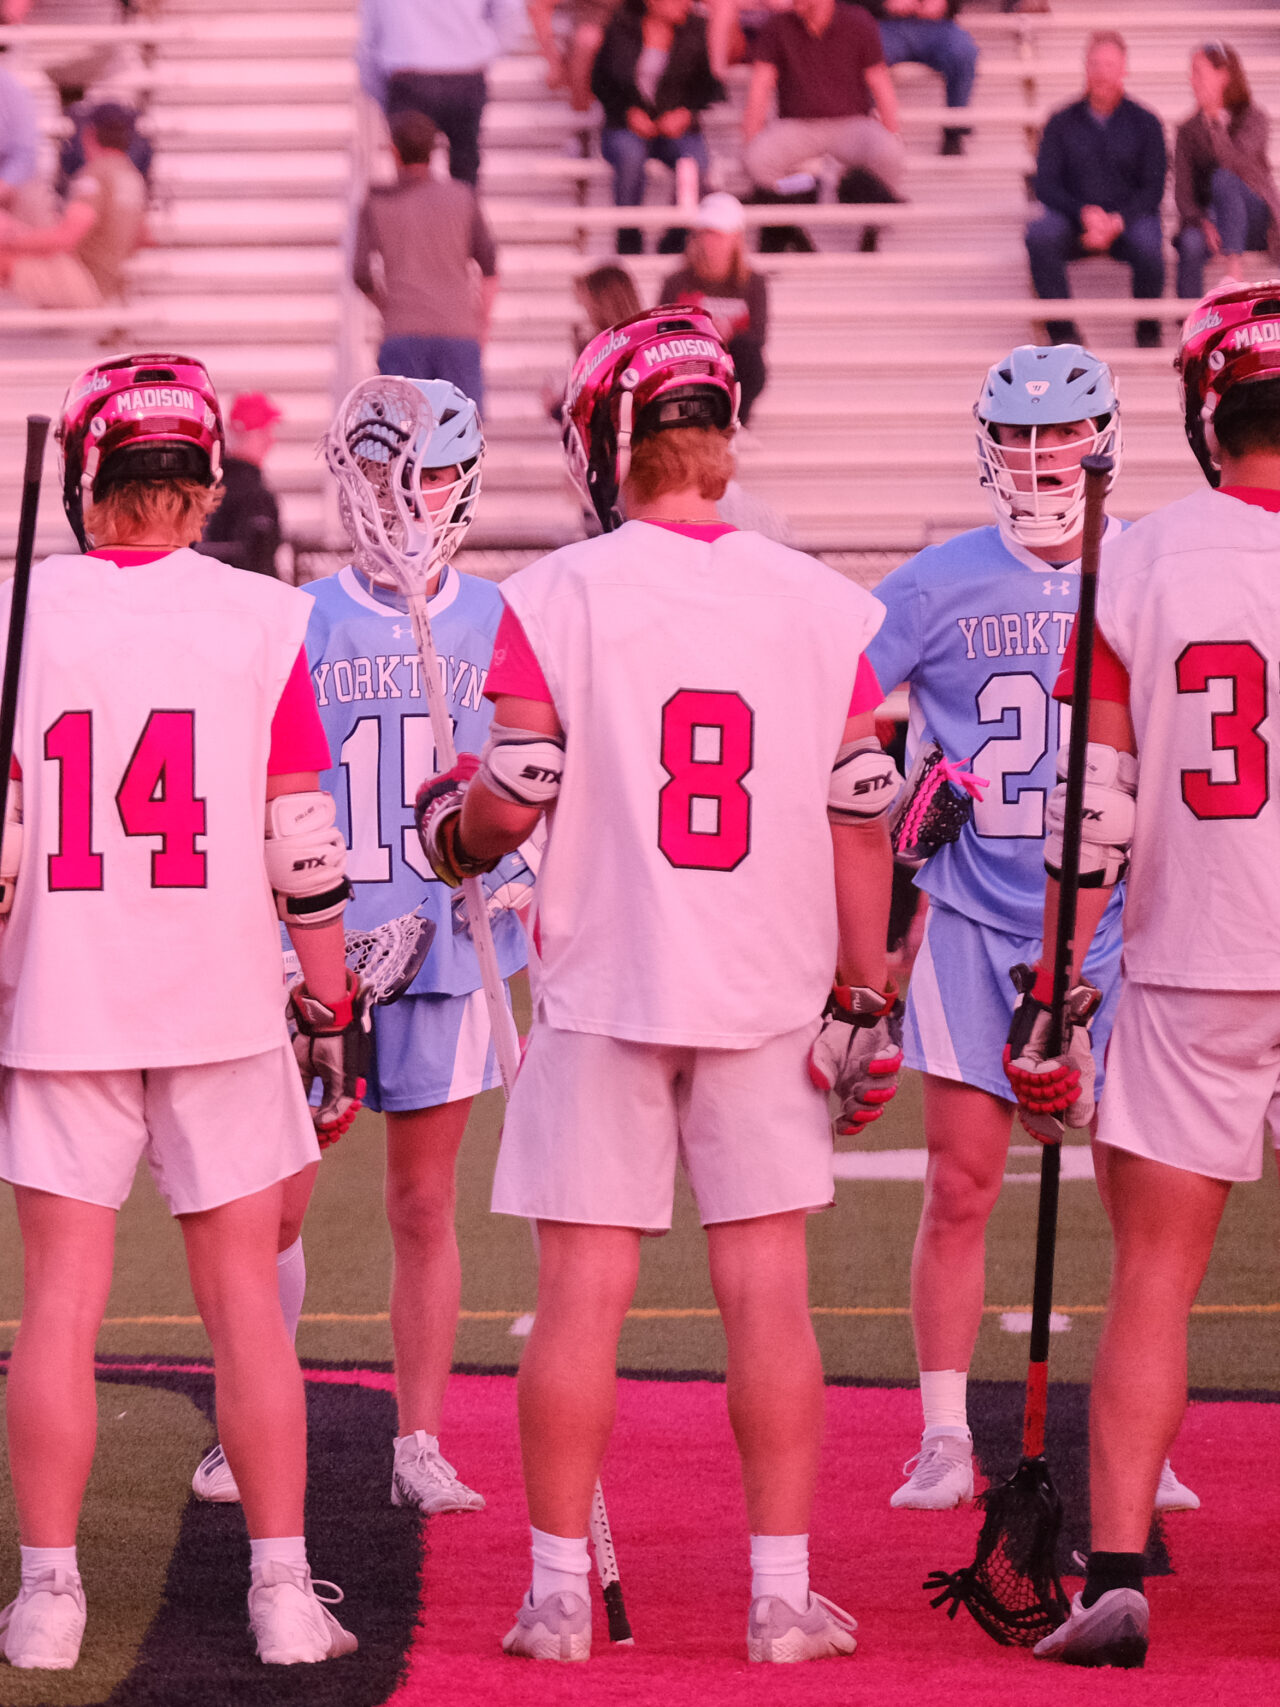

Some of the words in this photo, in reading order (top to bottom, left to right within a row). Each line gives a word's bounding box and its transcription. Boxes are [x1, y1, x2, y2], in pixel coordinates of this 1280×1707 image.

[1234, 322, 1280, 351] MADI
[643, 339, 719, 367] MADISON
[115, 388, 195, 413] MADISON
[957, 610, 1076, 660] YORKT
[1175, 640, 1280, 821] 3
[970, 670, 1073, 839] 2
[519, 764, 563, 784] STX
[657, 687, 755, 873] 8
[851, 770, 895, 796] STX
[43, 708, 208, 892] 14
[291, 854, 327, 872] STX
